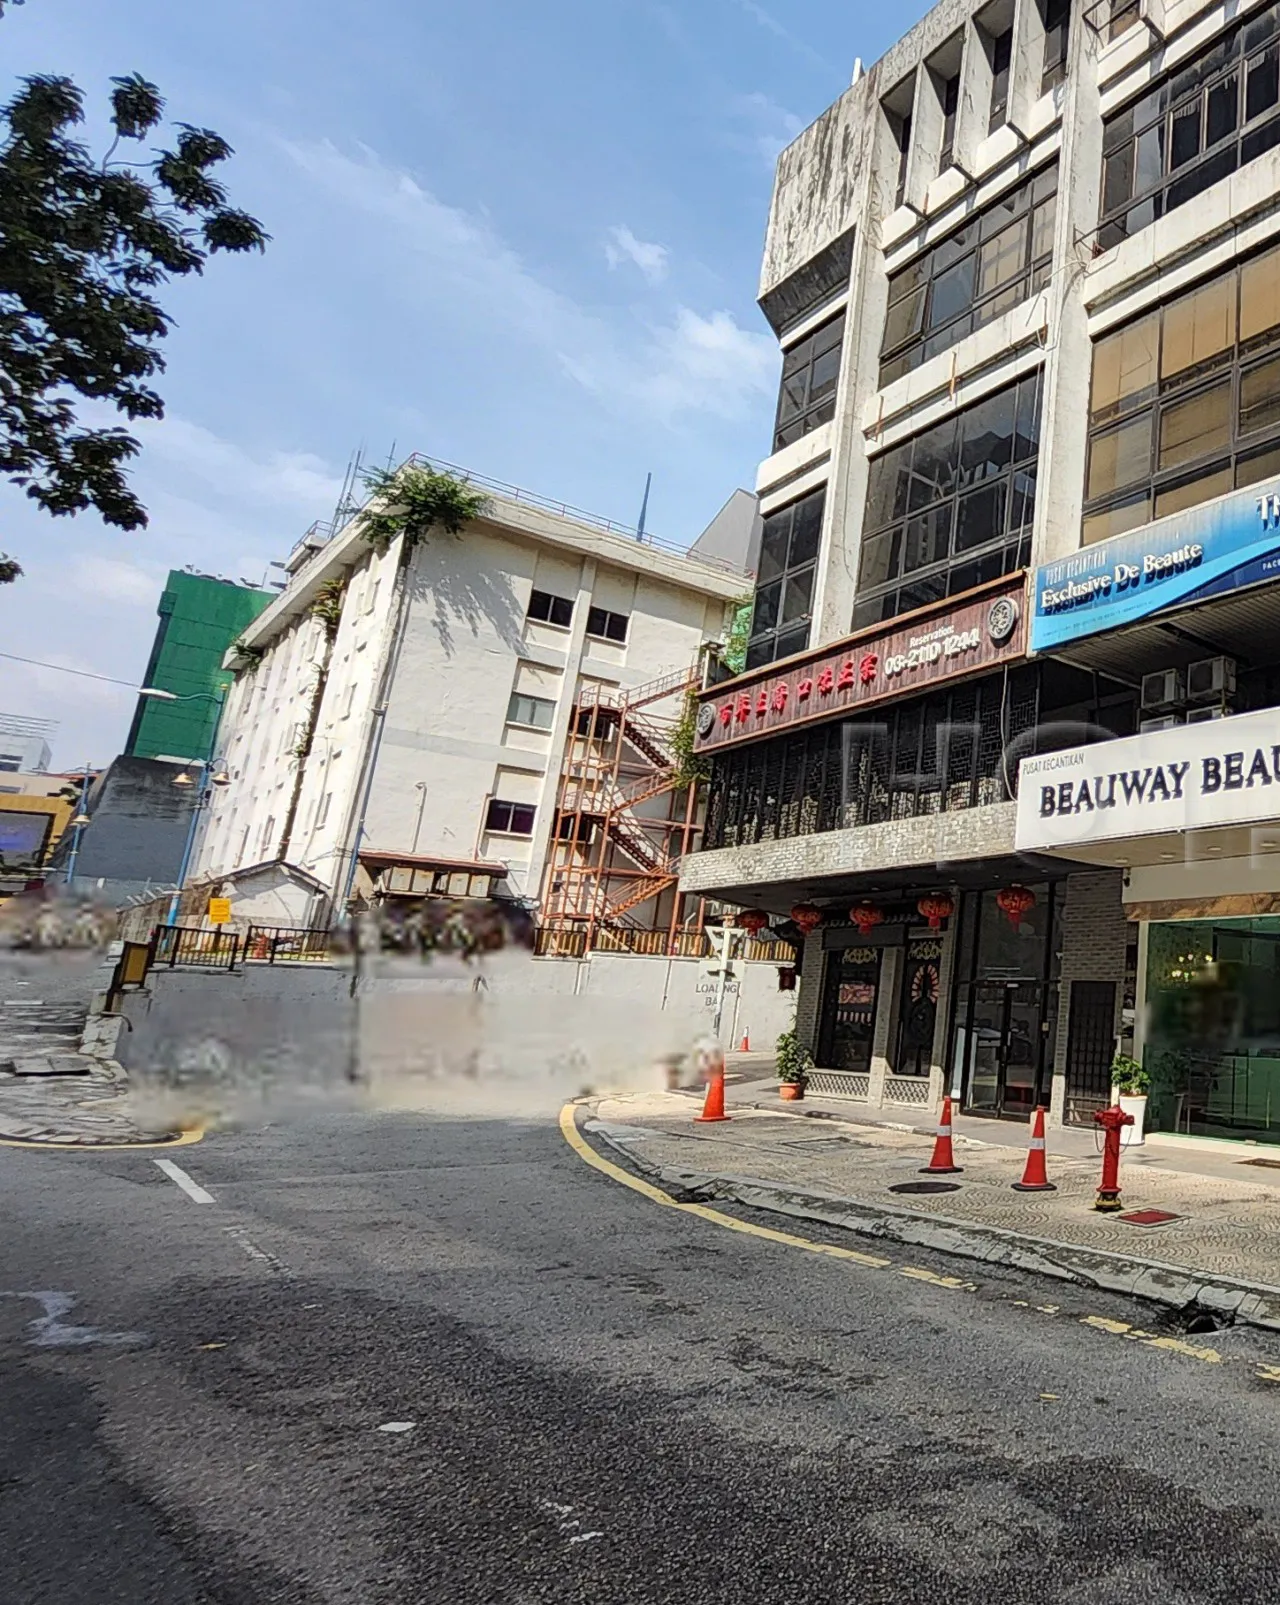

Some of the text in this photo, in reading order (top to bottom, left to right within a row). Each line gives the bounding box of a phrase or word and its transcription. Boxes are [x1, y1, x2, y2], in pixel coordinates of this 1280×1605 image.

[1041, 542, 1203, 608] Exclusive De Beaute
[943, 627, 981, 656] 1244
[1022, 752, 1084, 775] PUSAT KECANTIKAN
[1039, 760, 1190, 818] BEAUWAY
[695, 983, 737, 993] LOANG
